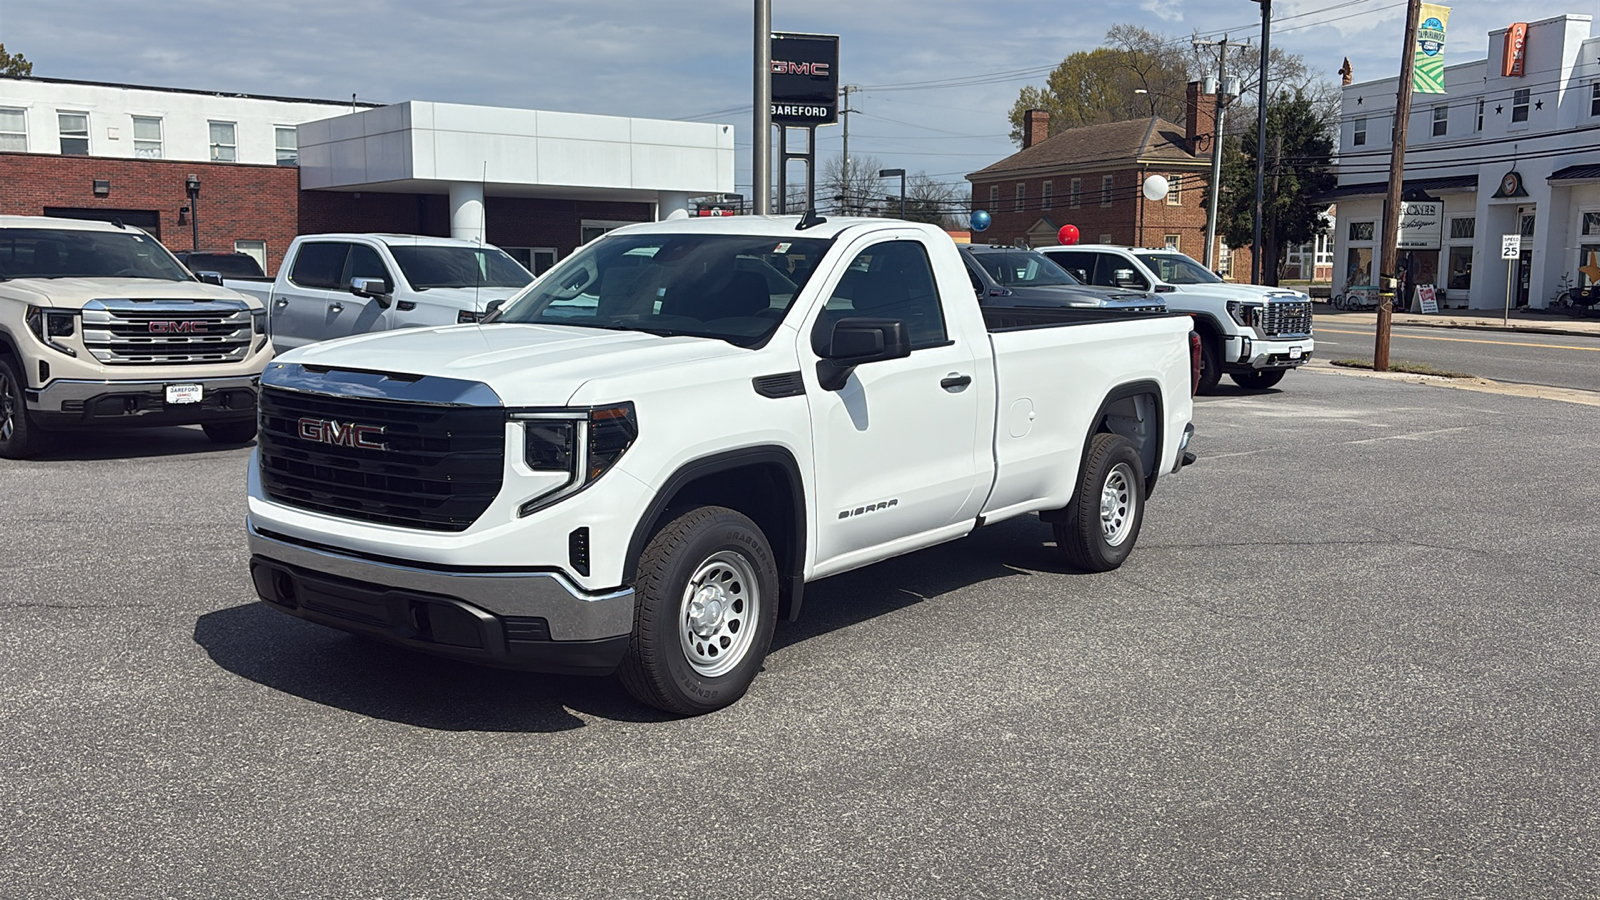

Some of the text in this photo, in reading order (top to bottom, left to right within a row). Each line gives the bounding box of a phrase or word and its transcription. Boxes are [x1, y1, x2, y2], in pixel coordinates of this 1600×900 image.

[1513, 26, 1523, 72] ACME
[771, 60, 829, 76] GMC
[771, 105, 828, 117] BAREFORD
[1503, 247, 1518, 257] 25
[149, 321, 208, 333] GMC
[298, 417, 387, 451] GMC
[838, 499, 898, 519] SIERRA
[726, 531, 767, 562] GRABBER
[676, 664, 718, 699] GENERAL
